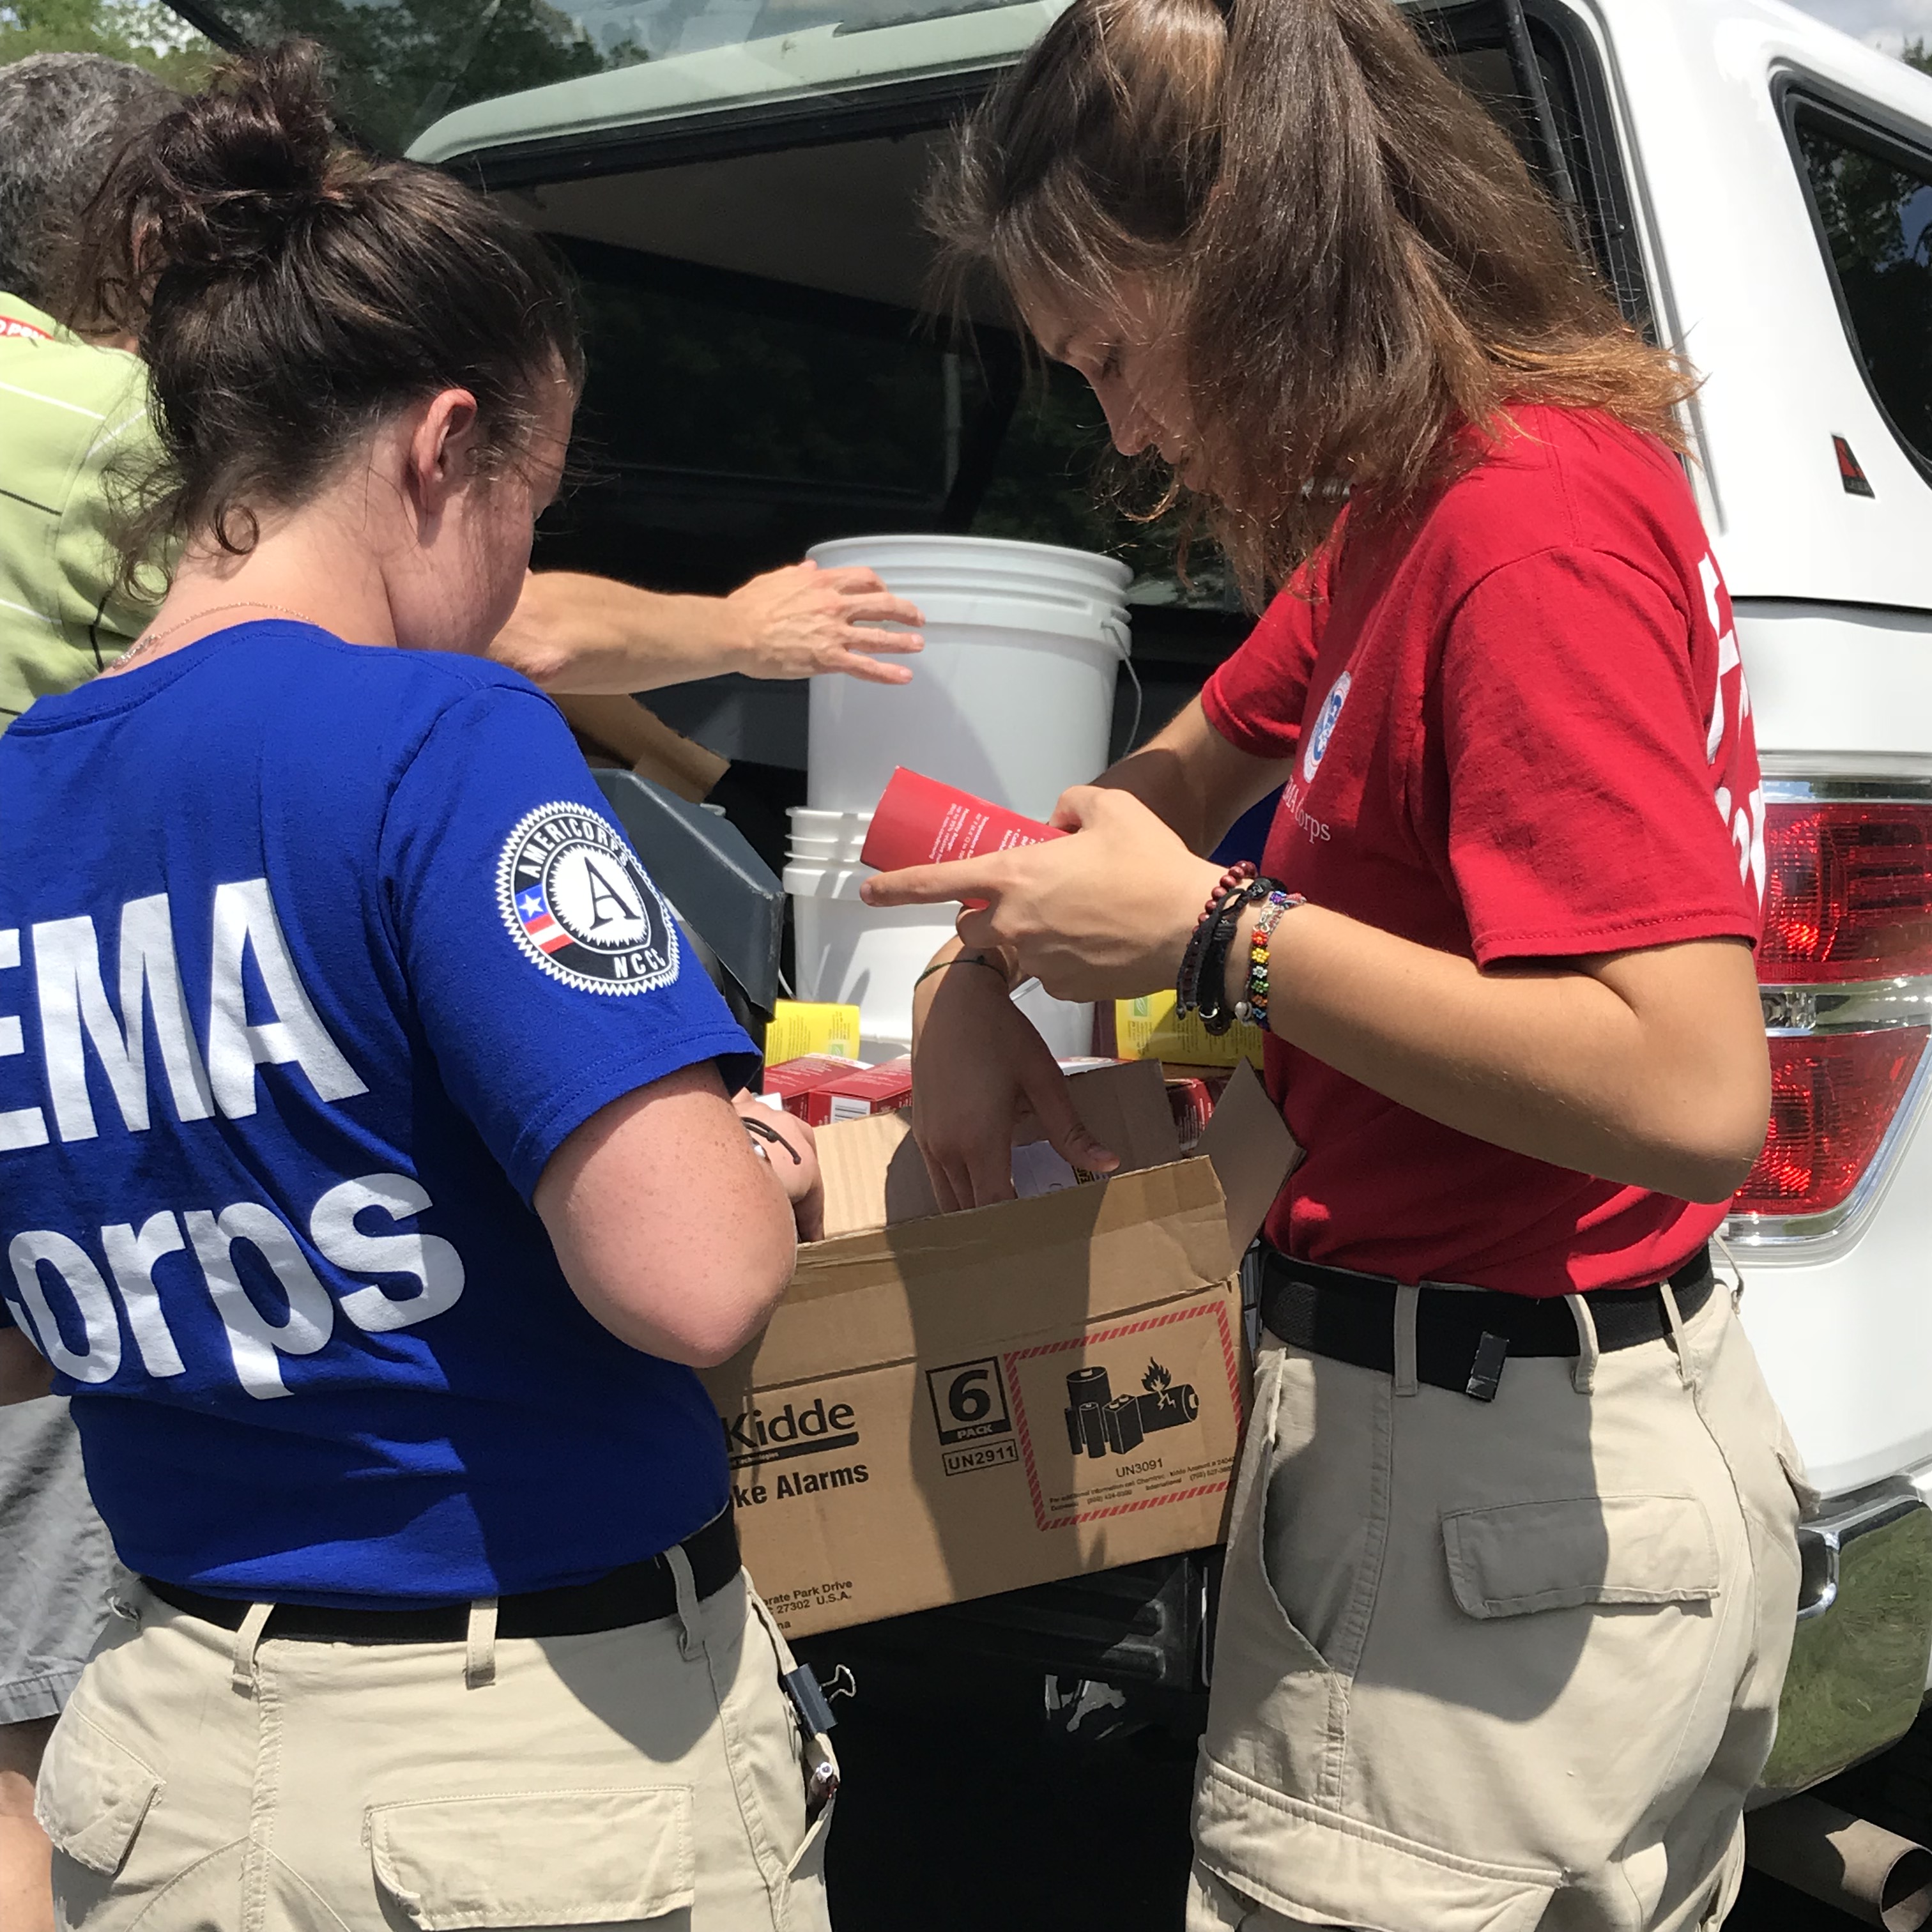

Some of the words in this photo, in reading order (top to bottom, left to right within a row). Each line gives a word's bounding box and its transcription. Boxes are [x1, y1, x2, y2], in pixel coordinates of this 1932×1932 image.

[954, 808, 970, 832] Humidity
[518, 818, 628, 878] AMERICORPS
[584, 856, 641, 931] A
[613, 948, 666, 978] NCCC
[4, 1173, 465, 1400] orps
[949, 1369, 991, 1422] 6
[721, 1398, 856, 1452] Kidde
[957, 1424, 993, 1439] PACK
[947, 1445, 1015, 1469] UN2911
[1116, 1457, 1163, 1478] UN3091
[732, 1485, 767, 1508] ke
[777, 1464, 870, 1499] Alarms
[777, 1599, 811, 1614] 27302
[816, 1590, 852, 1606] U.S.A.
[793, 1586, 820, 1599] Park
[822, 1580, 853, 1594] Drive
